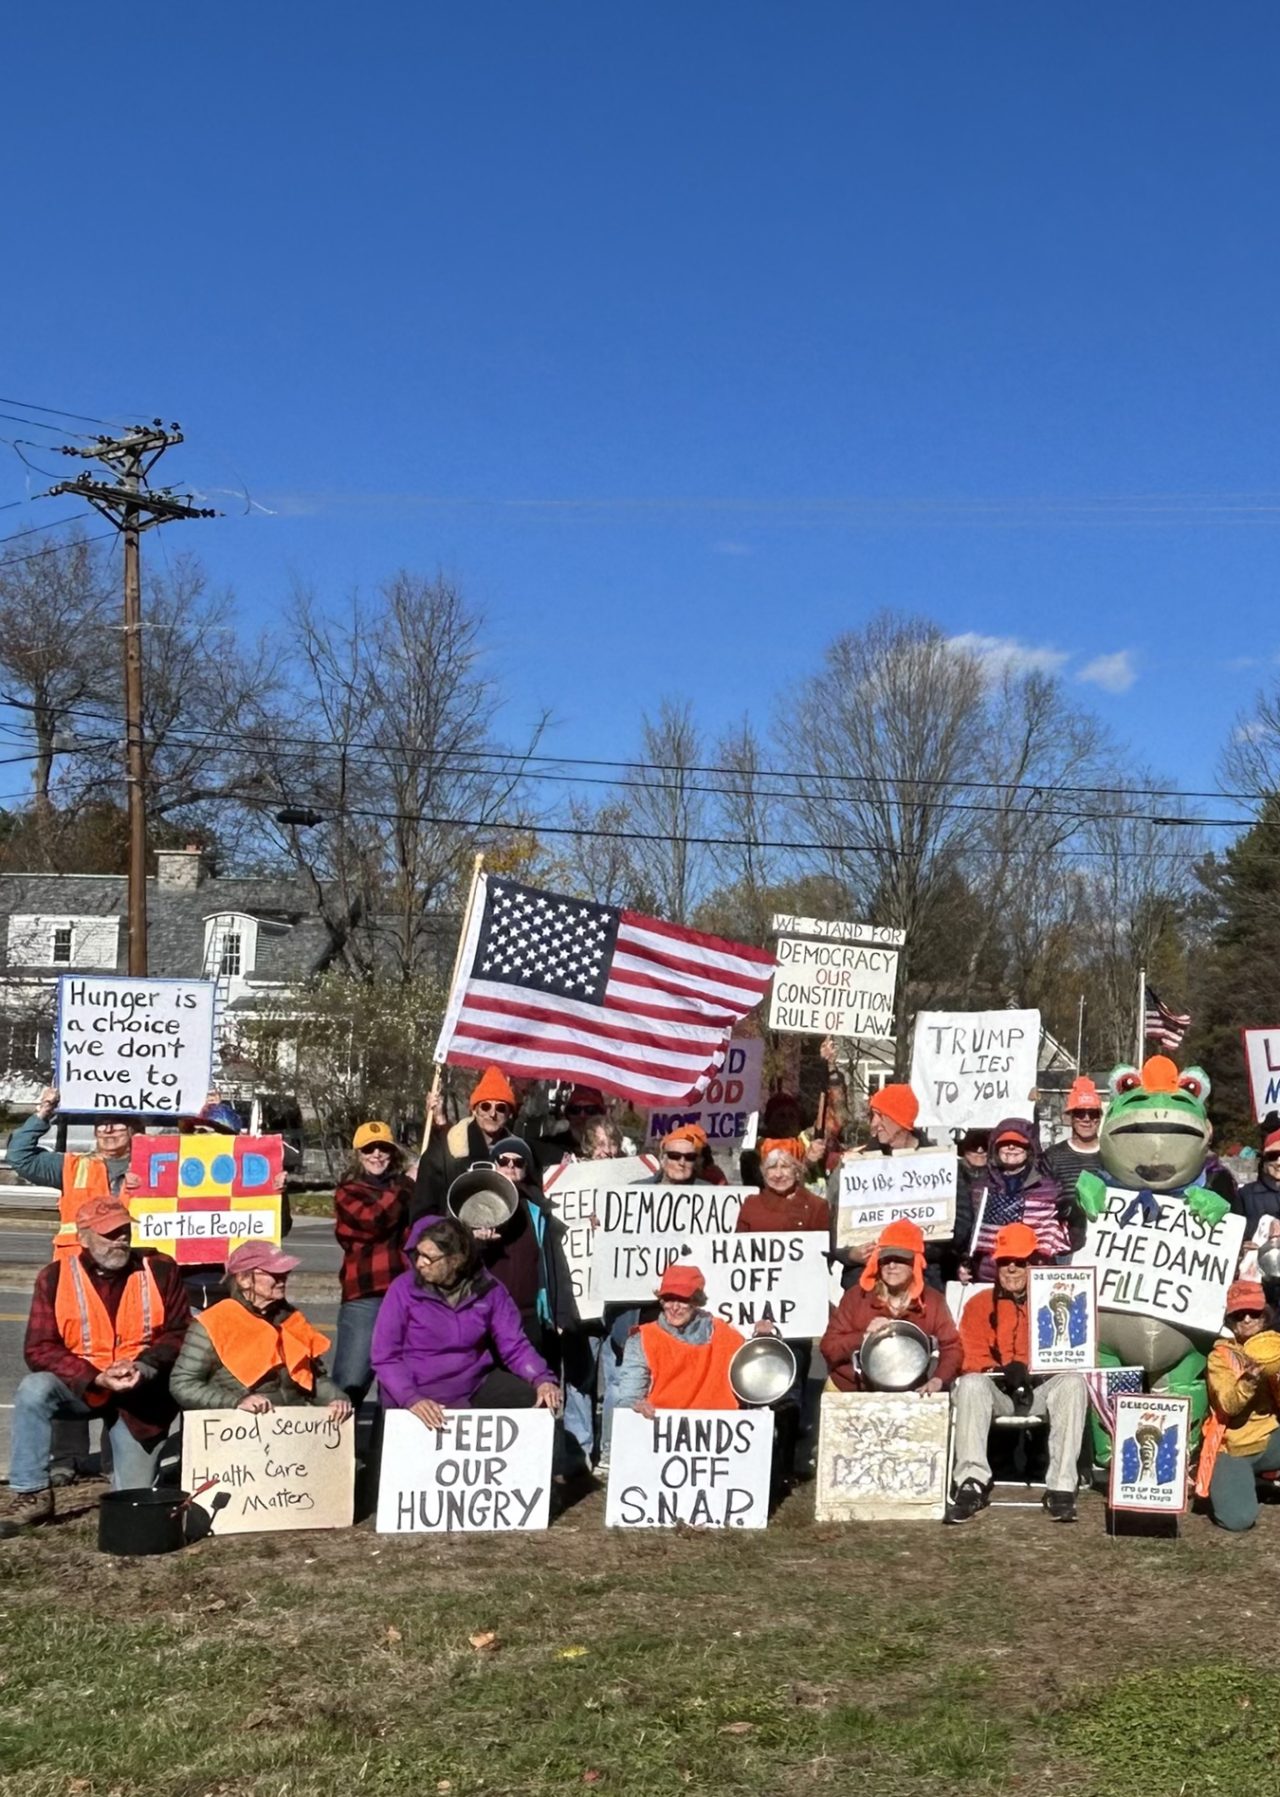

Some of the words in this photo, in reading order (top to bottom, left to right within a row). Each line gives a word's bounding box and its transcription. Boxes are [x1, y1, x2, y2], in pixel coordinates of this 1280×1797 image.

[775, 914, 801, 931] WE
[813, 919, 863, 938] STAND
[871, 926, 903, 943] FOR
[779, 940, 896, 973] DEMOCRACY
[815, 968, 852, 987] OUR
[70, 980, 161, 1021] Hunger
[175, 987, 197, 1009] is
[776, 982, 892, 1013] CONSTITUTION
[67, 1018, 85, 1032] a
[92, 1011, 181, 1033] choice
[776, 1006, 820, 1028] RULE
[824, 1011, 845, 1031] OF
[854, 1013, 892, 1036] LAW
[64, 1039, 105, 1056] we
[927, 1025, 1025, 1056] TRUMP
[66, 1060, 132, 1083] have
[147, 1064, 179, 1086] to
[958, 1055, 1014, 1075] LIES
[94, 1088, 183, 1112] make!
[706, 1079, 745, 1105] OD
[933, 1080, 960, 1106] TO
[973, 1079, 1009, 1101] YOU
[705, 1111, 748, 1139] ICE
[149, 1151, 270, 1189] FOOD
[844, 1175, 870, 1195] We
[872, 1173, 896, 1192] the
[900, 1167, 953, 1192] People
[143, 1213, 171, 1237] for
[176, 1214, 206, 1236] the
[210, 1213, 264, 1237] People
[858, 1209, 885, 1224] ARE
[891, 1206, 936, 1221] PISSED
[613, 1243, 651, 1279] IT'S
[655, 1247, 680, 1279] UP
[711, 1236, 805, 1265] HANDS
[1094, 1229, 1149, 1265] THE
[1152, 1240, 1230, 1286] DAMN
[730, 1266, 783, 1293] OFF
[717, 1299, 797, 1326] SNAP
[203, 1415, 262, 1451] Food
[271, 1415, 342, 1450] security
[434, 1414, 519, 1452] FEED
[652, 1416, 756, 1454] HANDS
[192, 1463, 256, 1492] Health
[434, 1456, 508, 1487] OUR
[660, 1455, 730, 1489] OFF
[397, 1486, 545, 1531] HUNGRY
[619, 1486, 755, 1526] S.N.A.P.
